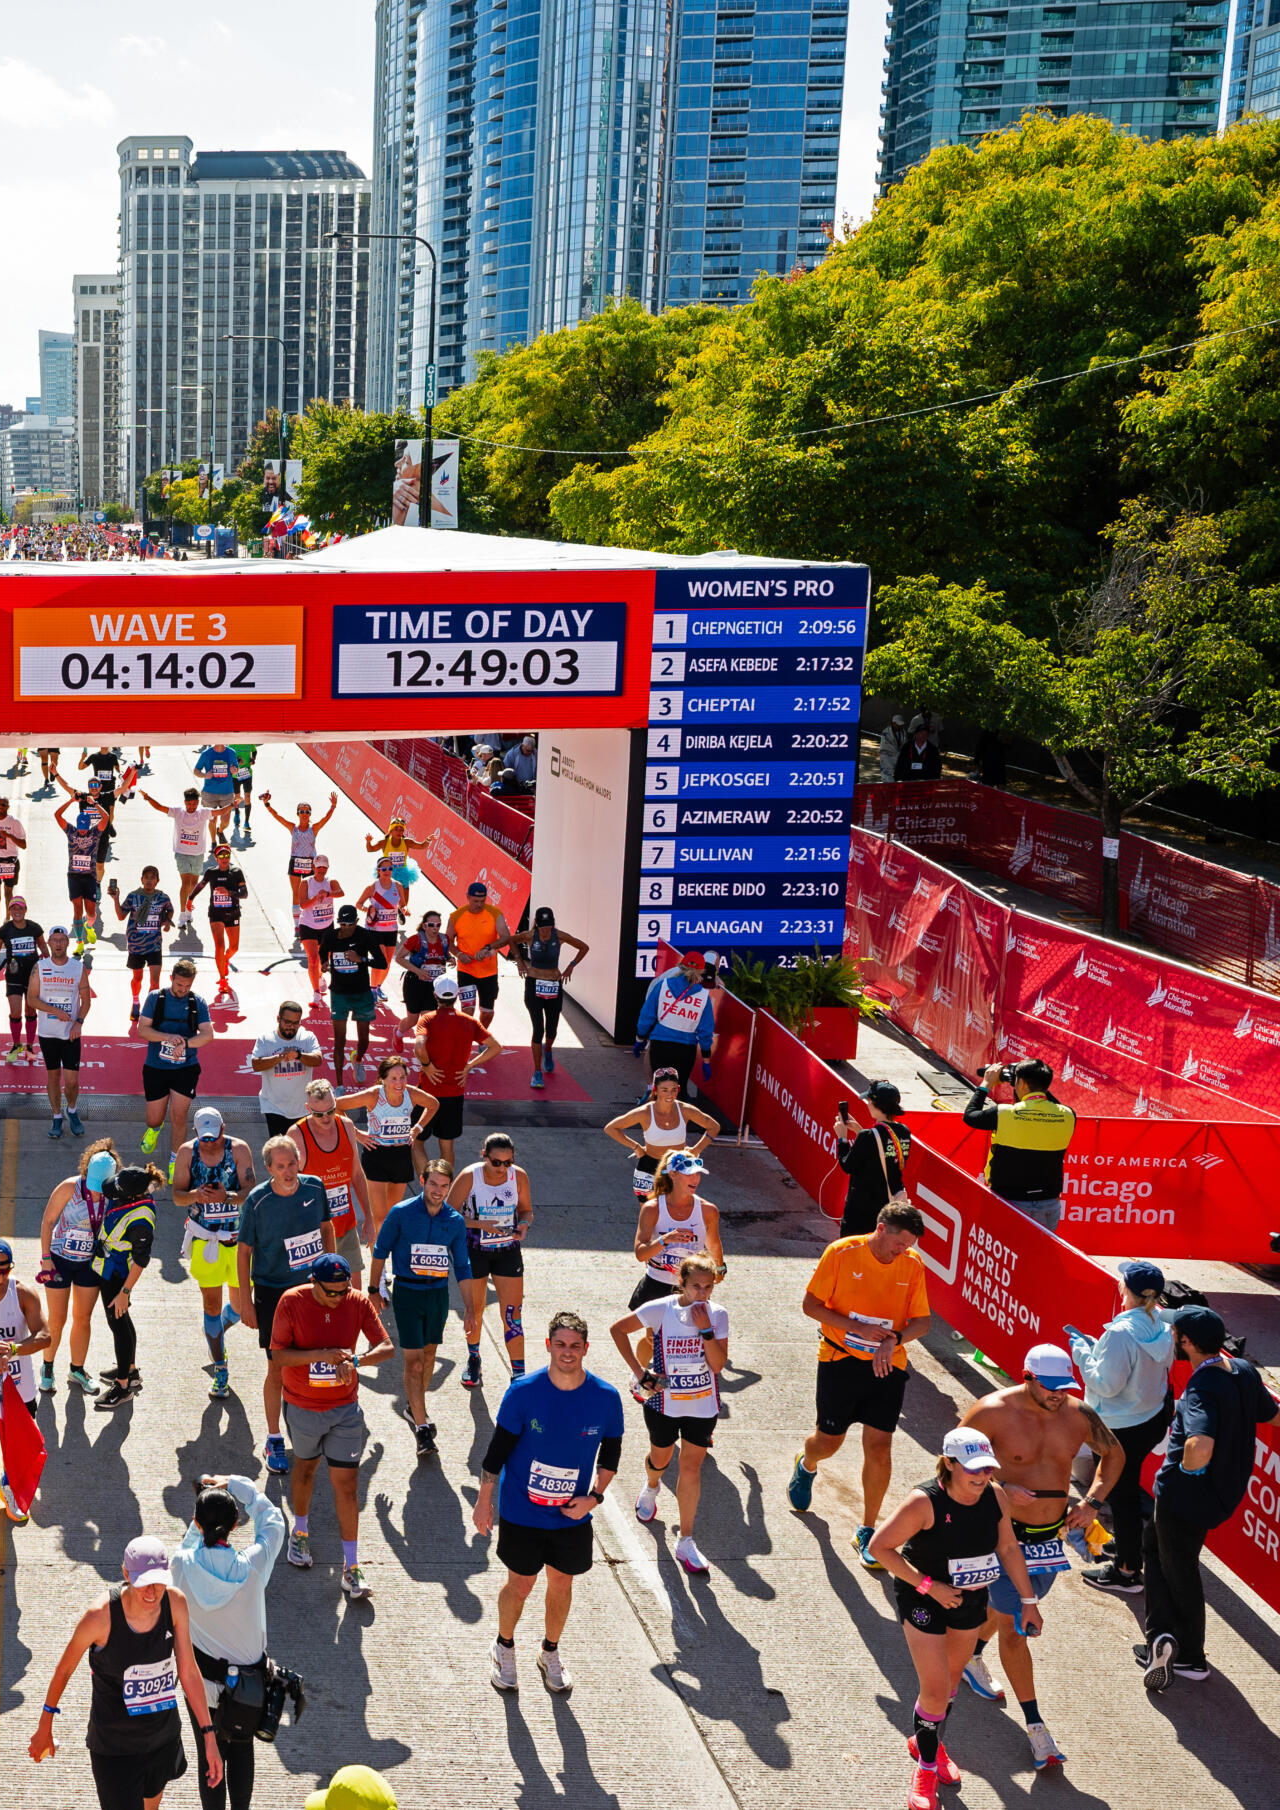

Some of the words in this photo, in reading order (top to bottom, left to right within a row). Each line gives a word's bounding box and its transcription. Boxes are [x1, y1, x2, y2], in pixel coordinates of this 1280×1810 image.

[793, 579, 835, 597] PRO
[90, 613, 195, 642] WAVE
[207, 613, 228, 641] 3
[365, 610, 453, 640] TIME
[463, 609, 512, 638] OF
[523, 608, 594, 638] DAY
[665, 620, 674, 638] 1
[691, 621, 783, 636] CHEPNGETICH
[798, 620, 857, 635] 2:09:56
[60, 651, 257, 690] 04:14:02
[386, 648, 581, 687] 12:49:03
[660, 657, 674, 676] 2
[688, 658, 729, 673] ASEFA
[730, 657, 779, 672] KEBEDE
[795, 656, 854, 671] 2:17:32
[658, 697, 672, 716] 3
[687, 698, 756, 713] CHEPTAI
[793, 697, 851, 712] 2:17:52
[656, 734, 671, 752] 4
[685, 735, 727, 750] DIRIBA
[729, 735, 773, 752] KEJELA
[791, 734, 849, 749] 2:20:22
[654, 772, 668, 790] 5
[682, 772, 770, 789] JEPKOSGEI
[788, 772, 845, 786] 2:20:51
[652, 809, 666, 828] 6
[681, 810, 771, 825] AZIMERAW
[786, 809, 843, 824] 2:20:52
[894, 814, 957, 832] Chicago
[651, 846, 664, 865] 7
[679, 847, 753, 862] SULLIVAN
[784, 847, 841, 861] 2:21:56
[648, 882, 663, 901] 8
[678, 882, 729, 897] BEKERE
[732, 882, 766, 897] DIDO
[781, 882, 840, 897] 2:23:10
[1151, 886, 1190, 916] Chicago
[647, 919, 661, 938] 9
[676, 920, 764, 934] FLANAGAN
[779, 920, 834, 934] 2:23:31
[1148, 907, 1197, 939] Marathon
[1163, 1000, 1194, 1018] Marathon
[1167, 992, 1193, 1008] Chicago
[669, 1003, 700, 1022] TEAM
[755, 1063, 780, 1101] BANK
[781, 1087, 793, 1109] OF
[792, 1104, 838, 1161] AMERICA
[386, 1125, 411, 1134] 44092
[1094, 1155, 1116, 1167] OF
[1118, 1156, 1189, 1169] AMERICA
[1062, 1172, 1154, 1204] hicago
[482, 1206, 514, 1214] Angelina
[294, 1241, 323, 1259] 40116
[968, 1222, 1019, 1269] ABBOTT
[420, 1255, 450, 1266] 60520
[966, 1241, 1012, 1287] WORLD
[963, 1263, 1042, 1335] MARATHON
[961, 1283, 1015, 1337] MAJORS
[666, 1338, 702, 1347] FINISH
[666, 1346, 700, 1355] STRONG
[680, 1370, 711, 1387] 65483
[539, 1477, 577, 1492] 48308
[963, 1567, 1001, 1585] 27595
[136, 1672, 175, 1696] 30925
